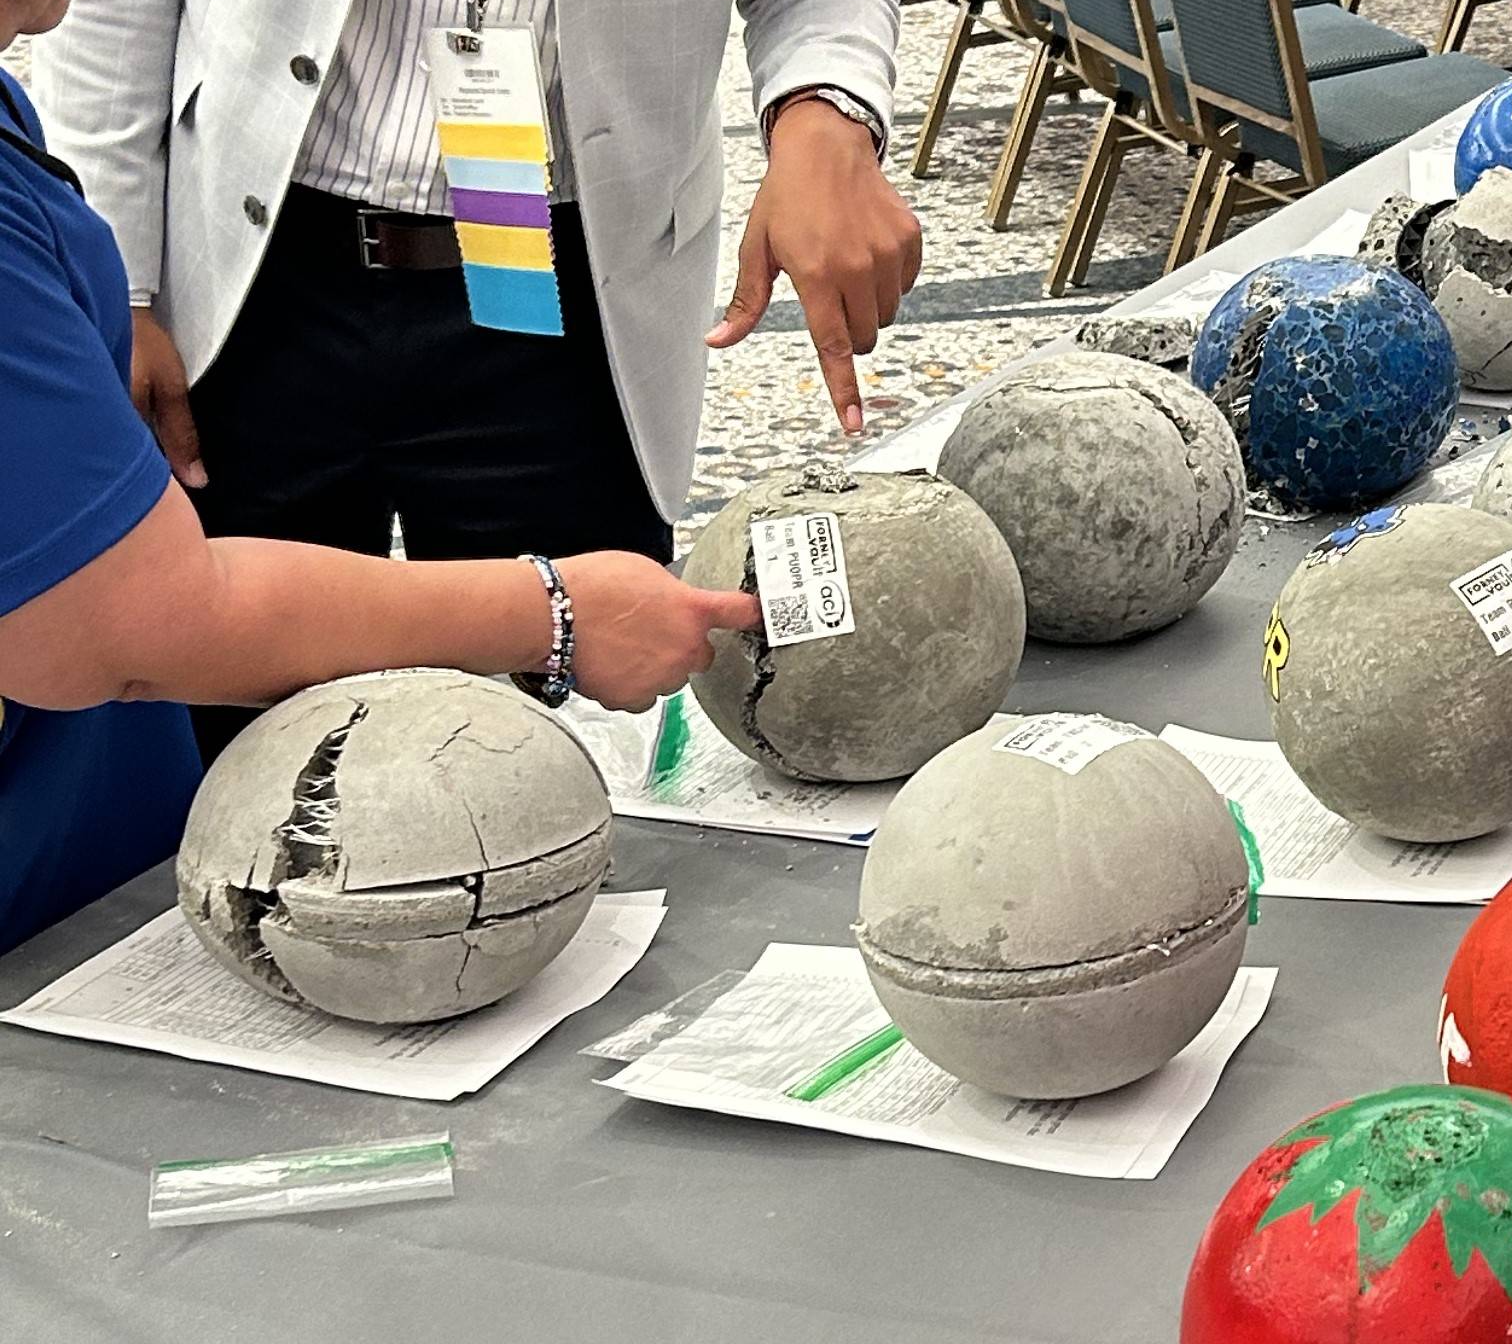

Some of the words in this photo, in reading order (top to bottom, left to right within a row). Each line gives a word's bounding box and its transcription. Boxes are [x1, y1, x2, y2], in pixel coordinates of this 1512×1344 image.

[1465, 567, 1506, 596] FORNEY
[820, 585, 836, 617] aci
[1479, 602, 1507, 625] Team
[1490, 624, 1512, 643] Ball
